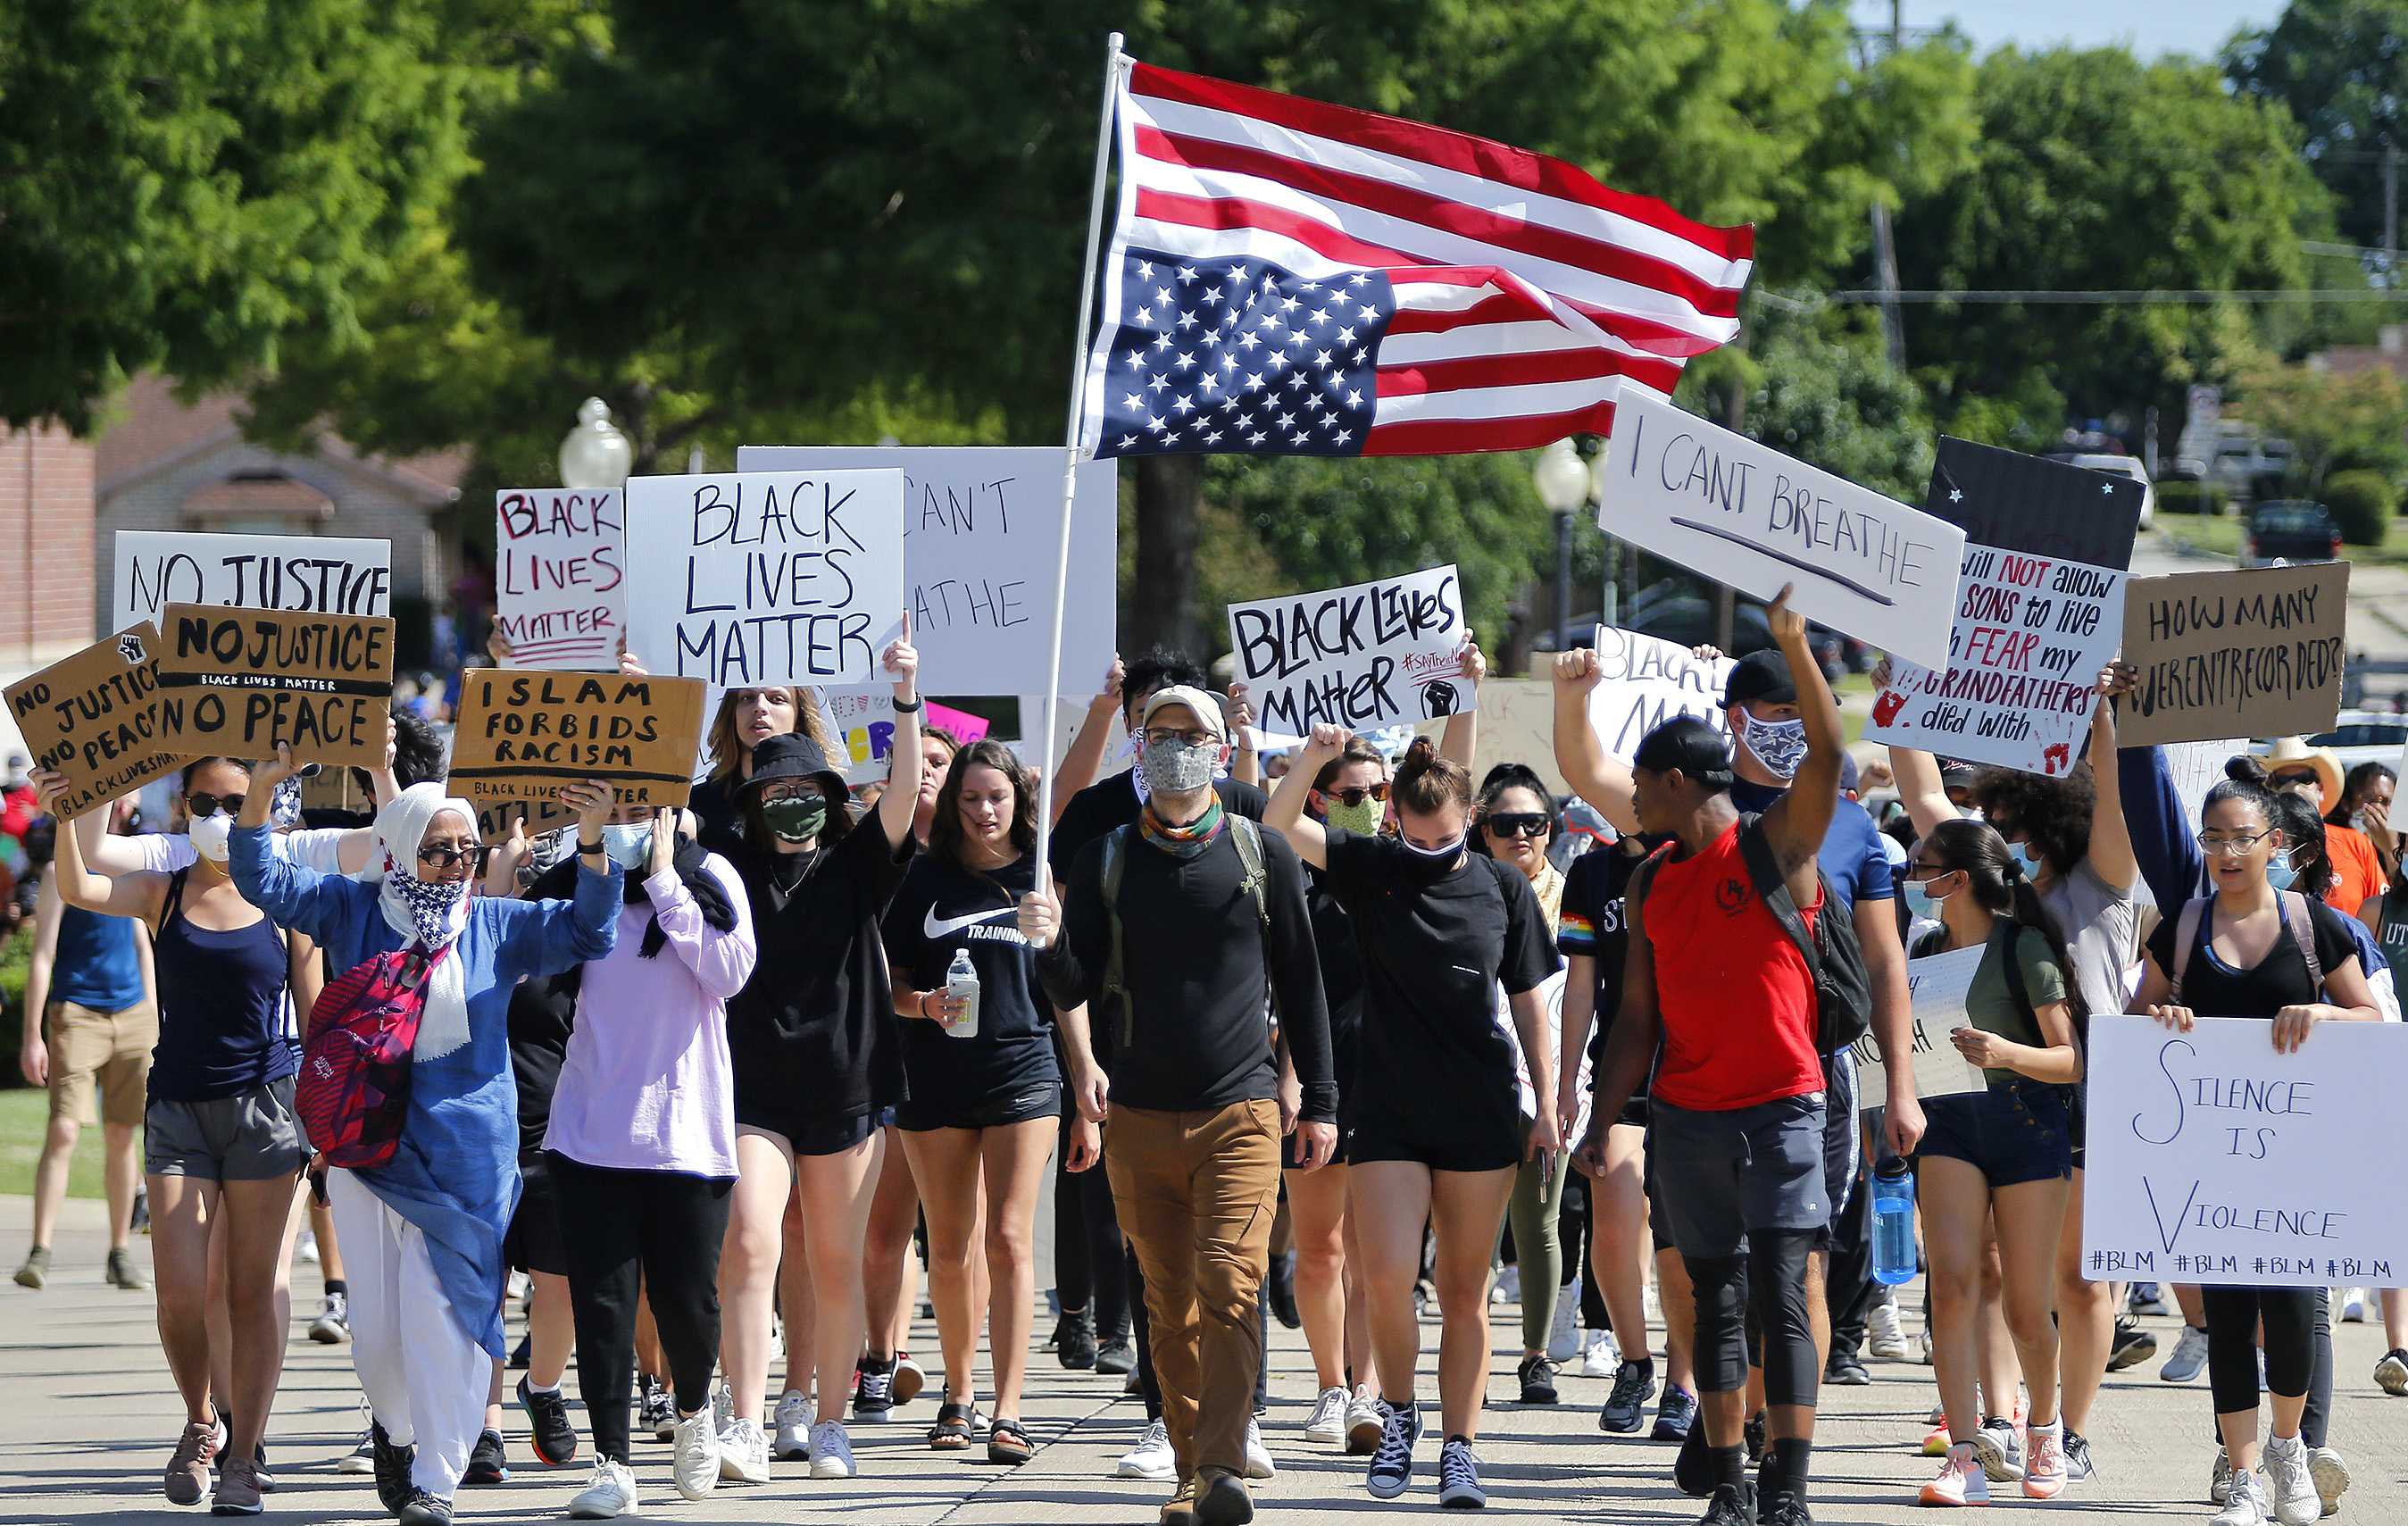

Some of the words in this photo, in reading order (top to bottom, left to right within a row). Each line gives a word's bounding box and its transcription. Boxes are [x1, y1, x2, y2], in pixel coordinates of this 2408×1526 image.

[499, 494, 621, 540] BLACK
[692, 480, 866, 553] BLACK
[904, 476, 1016, 537] AN'T
[1630, 415, 1645, 479] I
[1660, 434, 1756, 513] CANT
[1768, 473, 1935, 588] BREATHE
[129, 554, 203, 613] NO
[222, 555, 389, 617] JUSTICE
[506, 546, 621, 595] LIVES
[685, 547, 854, 614] LIVES
[1997, 555, 2052, 588] NOT
[2052, 565, 2117, 599] allow
[499, 605, 616, 642] MATTER
[1960, 583, 2021, 624] SONS
[2022, 596, 2053, 629] to
[2055, 599, 2101, 637] live
[2149, 595, 2225, 641] HOW
[2234, 583, 2319, 630] MANY
[177, 617, 244, 664] NO
[246, 621, 387, 671] JUSTICE
[676, 613, 874, 687] MATTER
[1234, 595, 1365, 680] BLACK
[1596, 625, 1705, 693] BLACK
[1963, 627, 2040, 672] FEAR
[2039, 646, 2082, 681] my
[15, 682, 51, 718] NO
[201, 674, 238, 686] BLACK
[244, 676, 276, 687] LIVES
[285, 678, 336, 691] MATTER
[482, 677, 652, 708] ISLAM
[1923, 667, 2096, 716] GRANDFATHERS
[162, 693, 226, 738] NO
[244, 693, 367, 750] PEACE
[486, 713, 659, 742] FORBIDS
[1921, 702, 1972, 734] died
[1976, 710, 2030, 741] with
[39, 739, 77, 771] NO
[495, 740, 632, 767] RACISM
[474, 781, 515, 796] BLACK
[2132, 1039, 2315, 1145] SILENCE
[2225, 1127, 2277, 1160] IS
[2143, 1175, 2348, 1255] VIOLENCE
[2087, 1249, 2155, 1272] #BLM
[2173, 1254, 2238, 1274] #BLM
[2250, 1256, 2315, 1275] #BLM
[2326, 1258, 2392, 1279] #BLM
